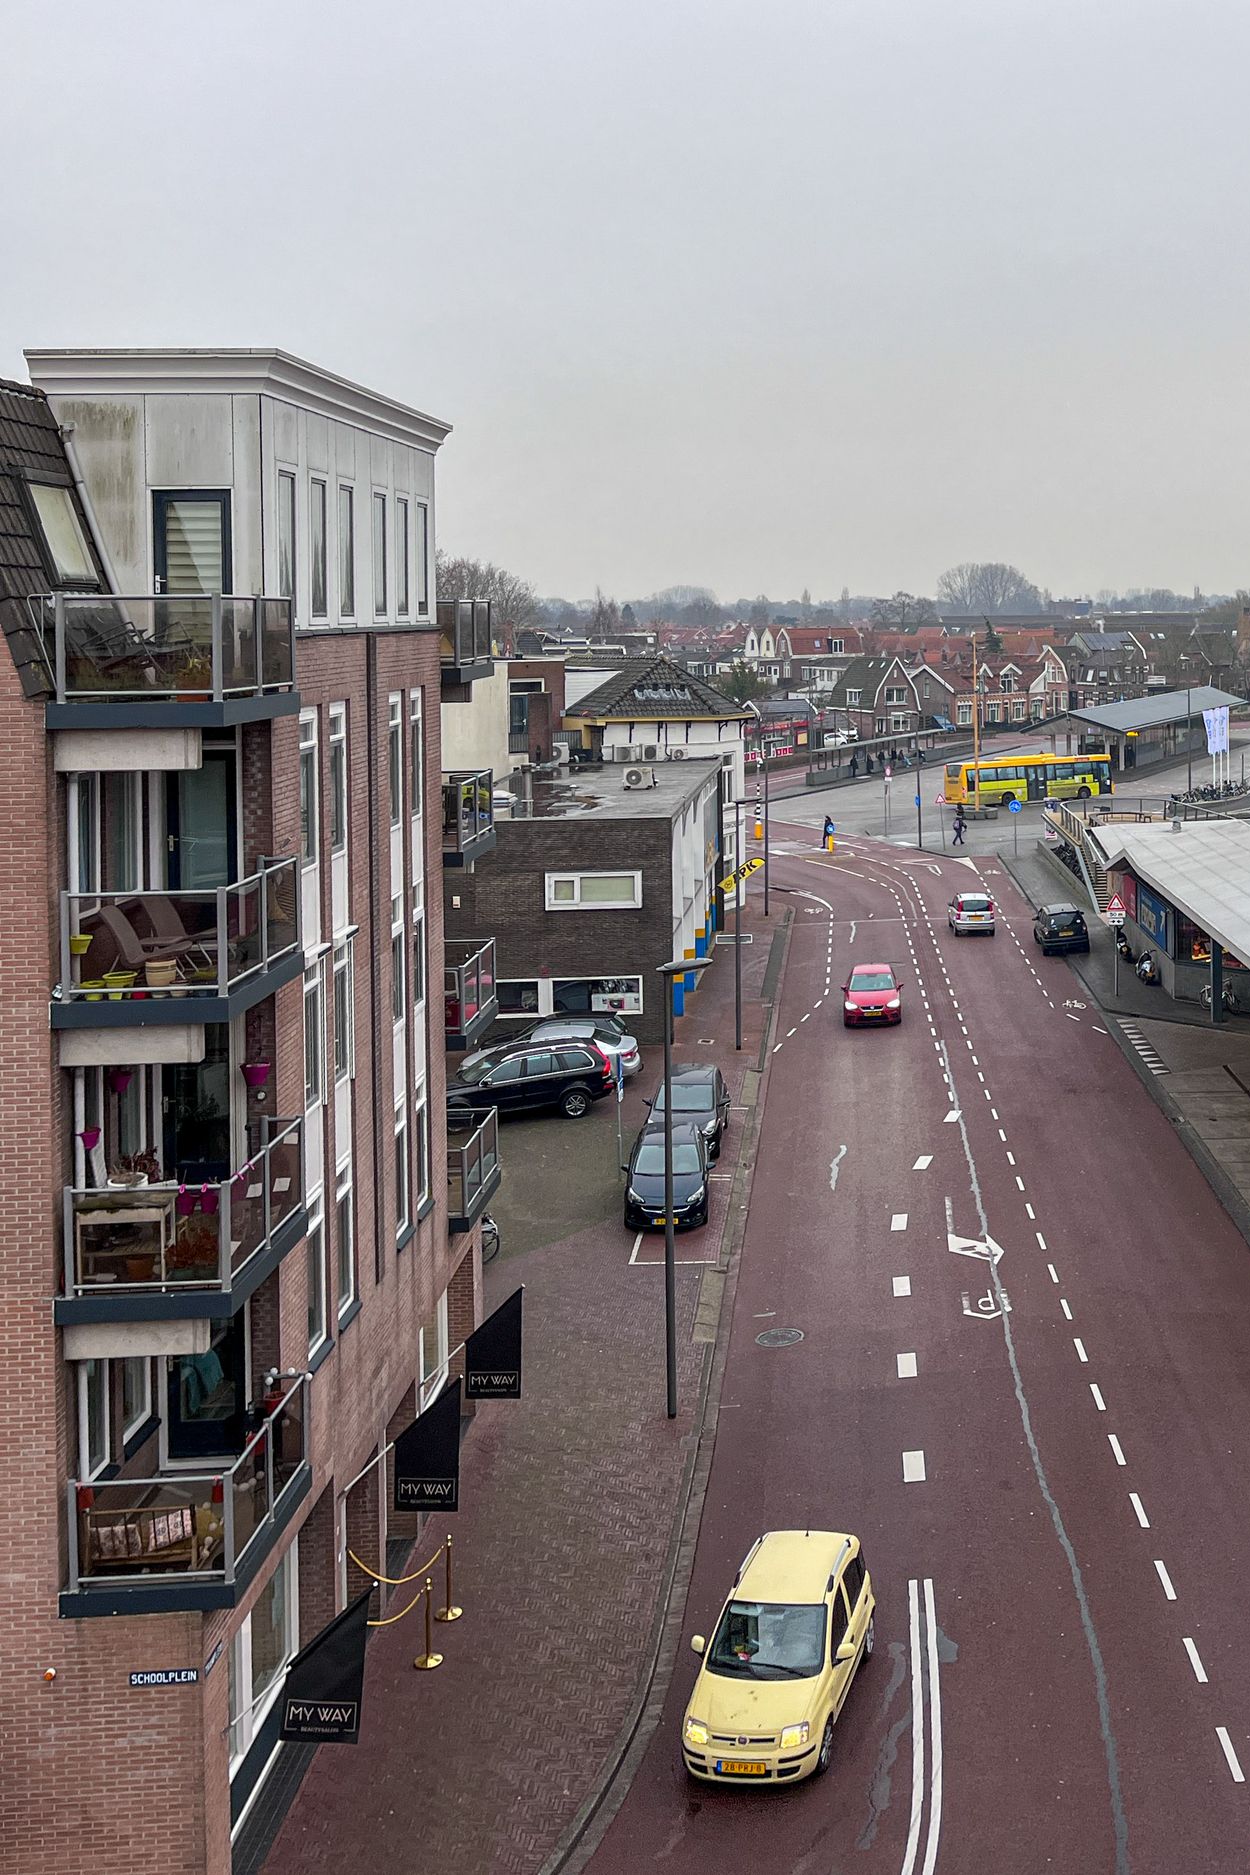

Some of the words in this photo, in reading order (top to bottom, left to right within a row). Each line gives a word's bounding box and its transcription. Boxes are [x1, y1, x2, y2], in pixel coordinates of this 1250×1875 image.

[471, 1375, 489, 1385] MY
[490, 1375, 515, 1385] WAY
[401, 1483, 420, 1495] MY
[423, 1483, 451, 1495] WAY
[131, 1670, 197, 1685] SCHOOLPLEIN
[289, 1706, 314, 1721] MY
[317, 1706, 352, 1722] WAY
